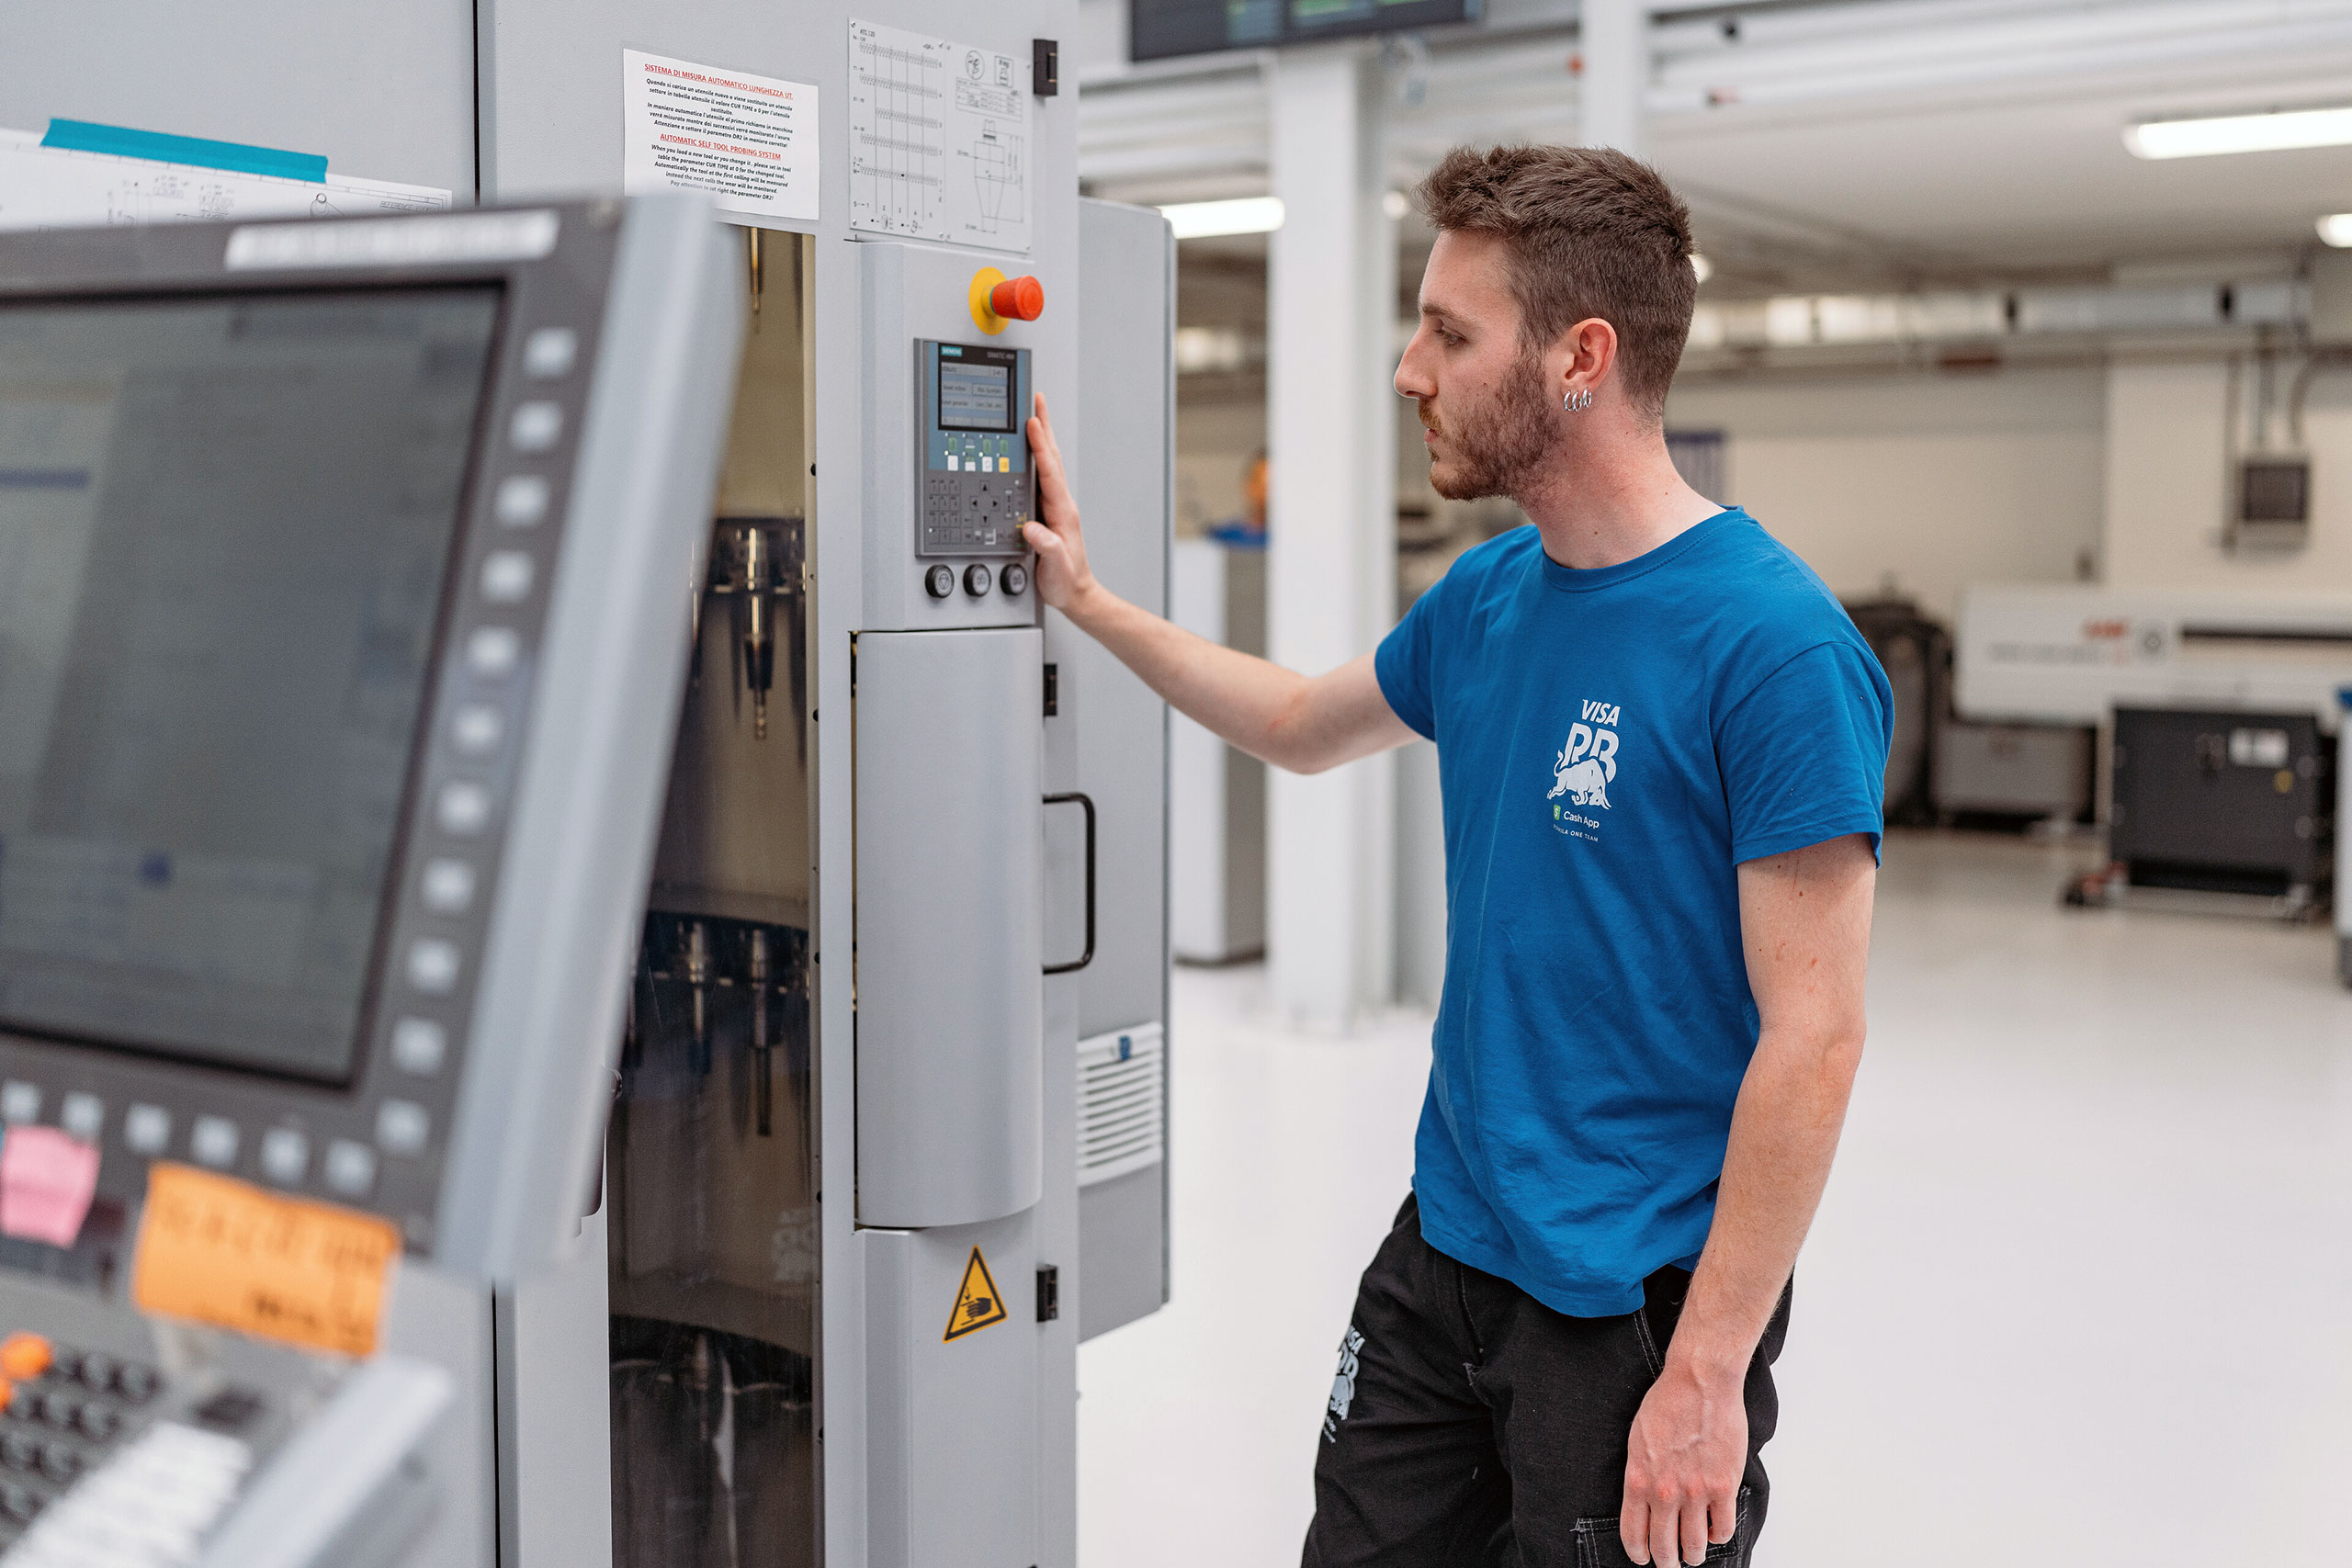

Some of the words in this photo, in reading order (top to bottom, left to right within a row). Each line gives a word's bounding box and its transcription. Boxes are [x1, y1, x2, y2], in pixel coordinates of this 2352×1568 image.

[645, 64, 672, 74] SISTEMA
[682, 71, 706, 81] MISURA
[708, 77, 748, 90] AUTOMATICO
[749, 85, 784, 97] LUNGHEZZA
[660, 133, 697, 146] AUTOMATIC
[713, 142, 729, 151] TOOL
[730, 145, 757, 156] PROBING
[758, 150, 781, 160] SYSTEM
[654, 161, 689, 172] Automatically
[1582, 699, 1620, 727] VISA
[1563, 811, 1582, 823] Cash
[1584, 816, 1599, 829] App
[1585, 834, 1598, 842] TEAM
